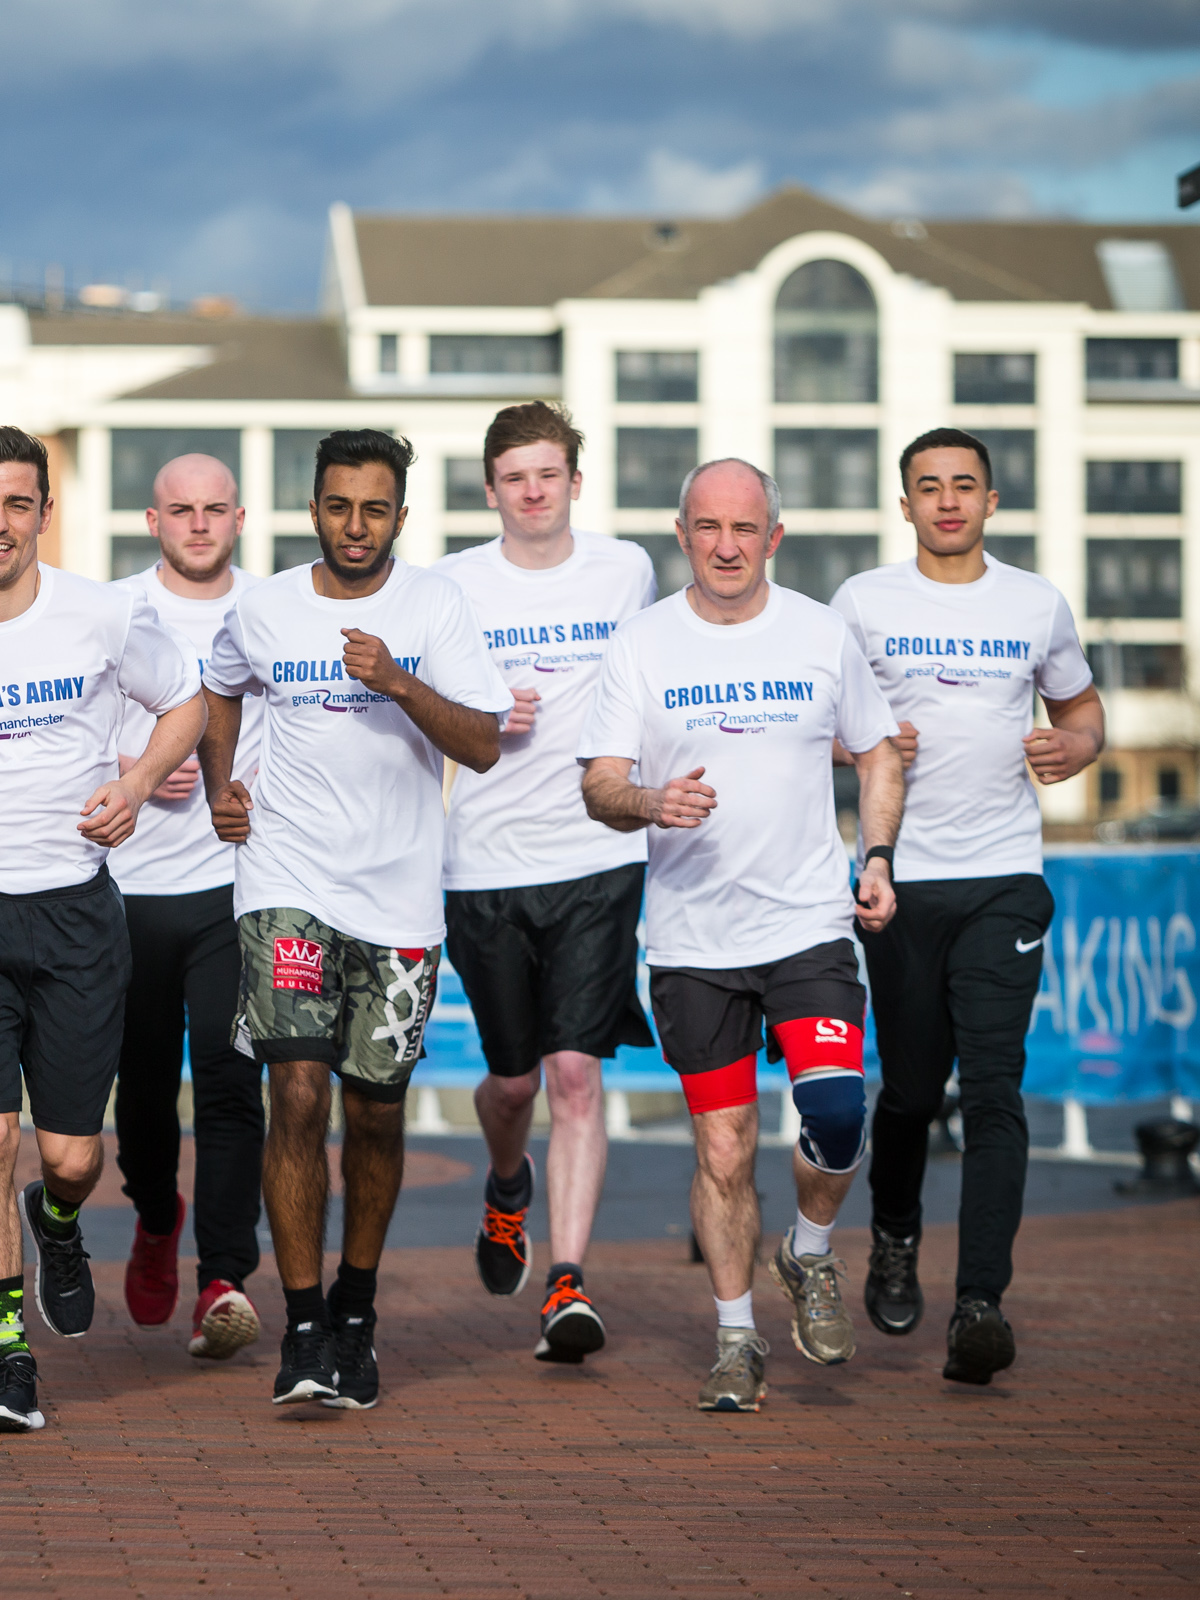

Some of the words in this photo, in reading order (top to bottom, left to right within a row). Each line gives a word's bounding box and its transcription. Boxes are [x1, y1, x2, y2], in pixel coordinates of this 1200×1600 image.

[885, 637, 974, 657] CROLLA'S
[979, 639, 1031, 660] ARMY
[273, 660, 359, 683] CROLLA
[905, 666, 935, 679] great
[946, 666, 1012, 679] manchester
[26, 676, 85, 704] ARMY
[292, 692, 321, 707] great
[332, 691, 397, 703] manchest
[664, 681, 757, 709] CROLLA'S
[762, 681, 814, 701] ARMY
[686, 714, 717, 731] great
[729, 712, 799, 724] manchester
[276, 967, 320, 980] MUHAMMAD
[276, 980, 319, 992] MULLA
[403, 964, 434, 1062] ULTIMATE
